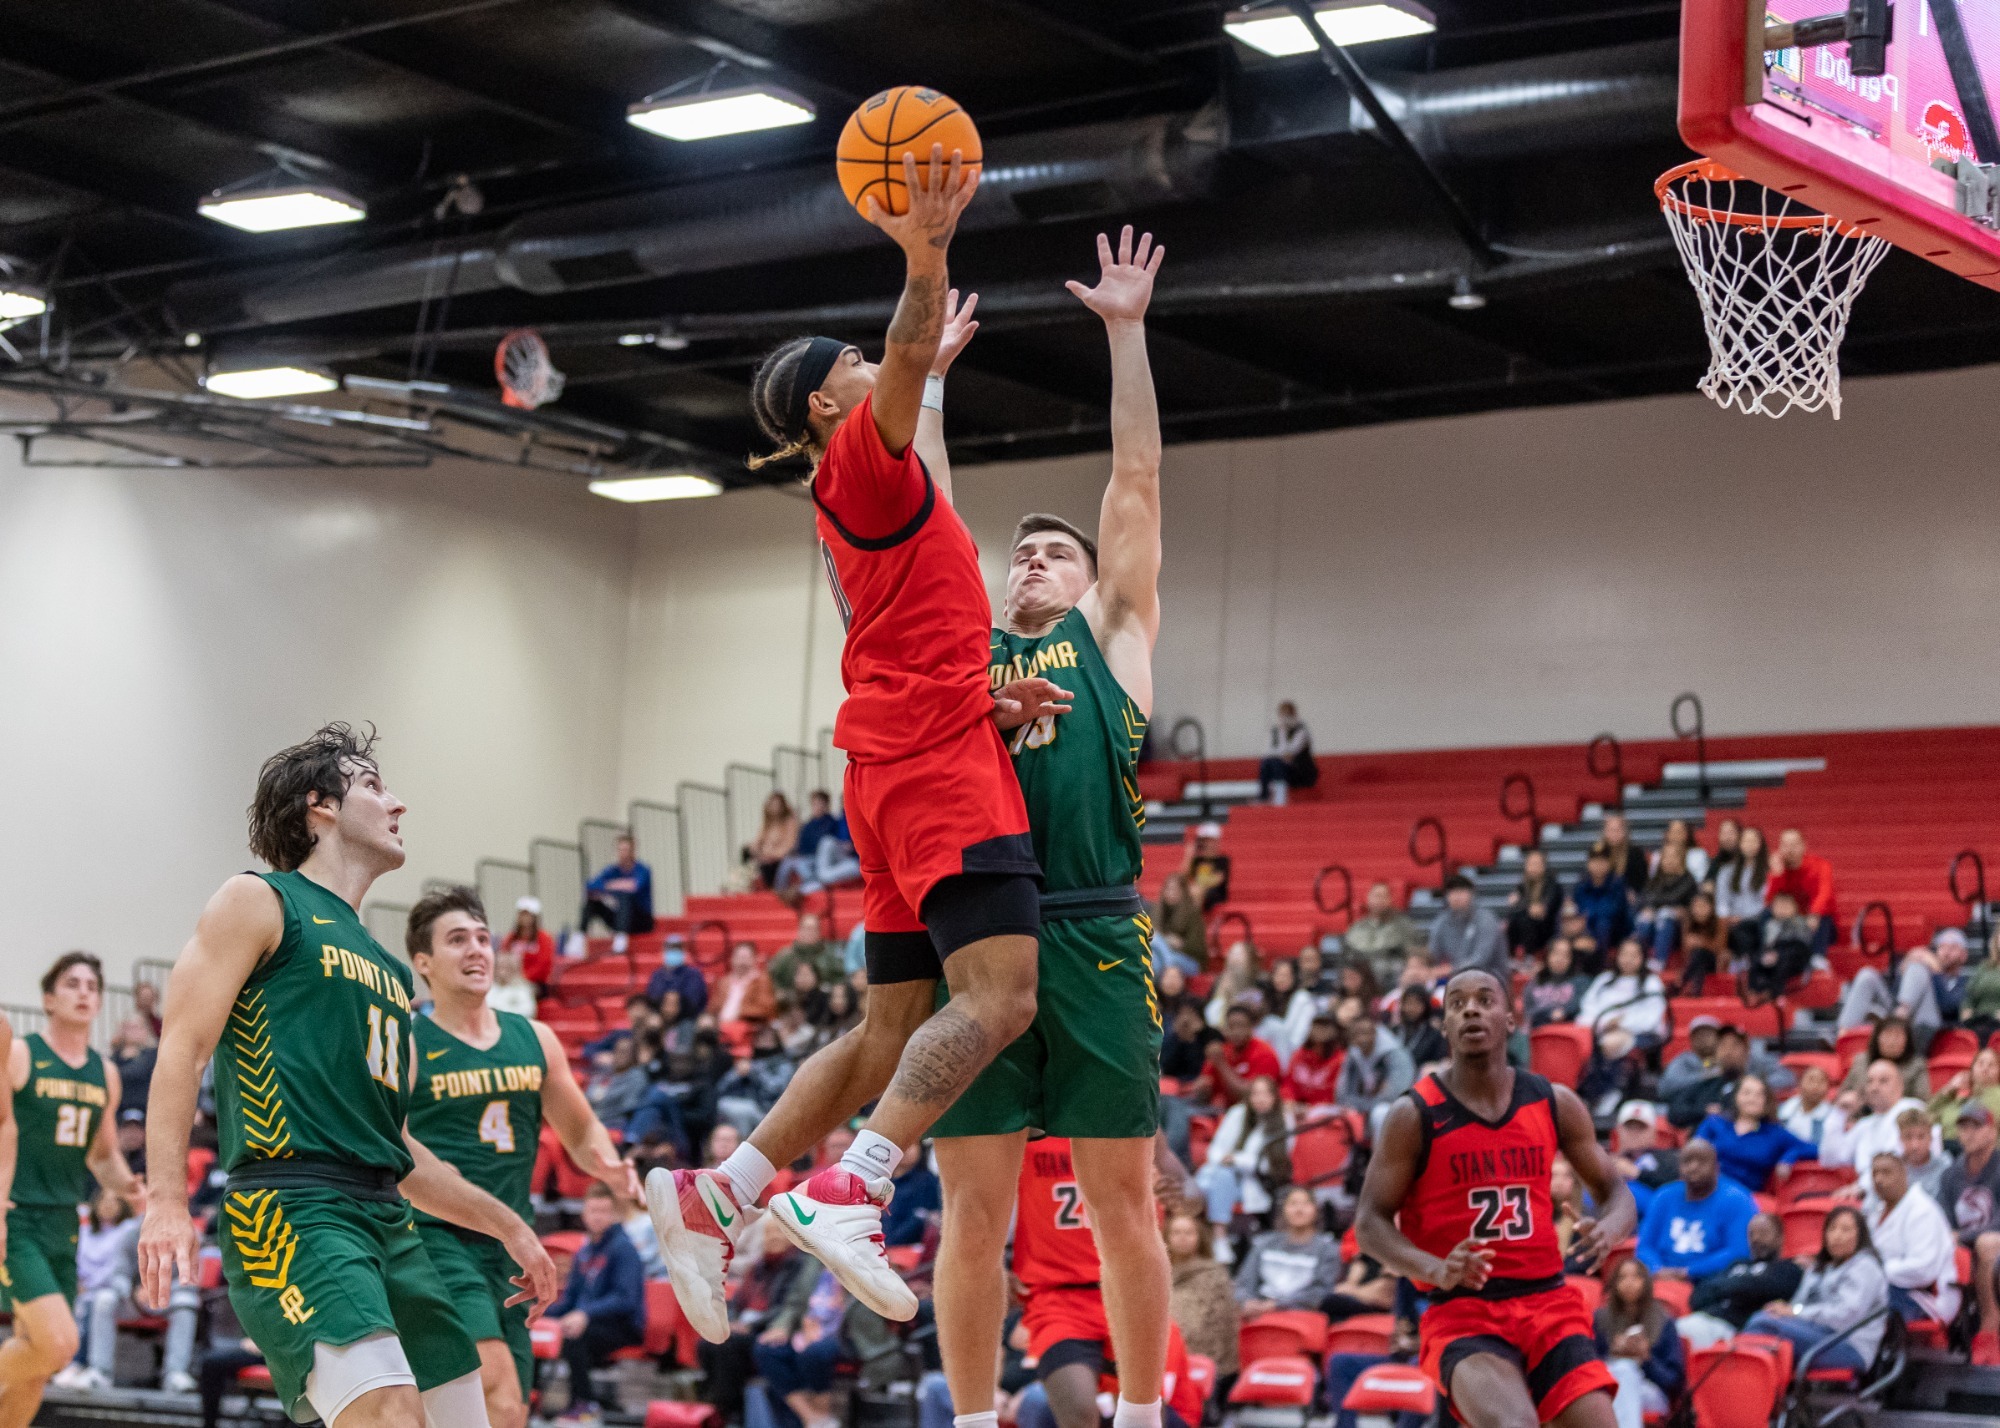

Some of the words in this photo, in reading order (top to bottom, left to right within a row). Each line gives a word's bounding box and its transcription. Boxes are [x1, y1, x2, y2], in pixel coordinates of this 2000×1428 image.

[319, 944, 382, 995] POINT
[366, 1003, 400, 1093] 11
[430, 1068, 492, 1101] POINT
[54, 1104, 92, 1148] 21
[478, 1100, 516, 1154] 4
[1450, 1149, 1496, 1185] STAN
[1501, 1145, 1546, 1178] STATE
[1051, 1181, 1092, 1231] 2
[1467, 1184, 1534, 1241] 23
